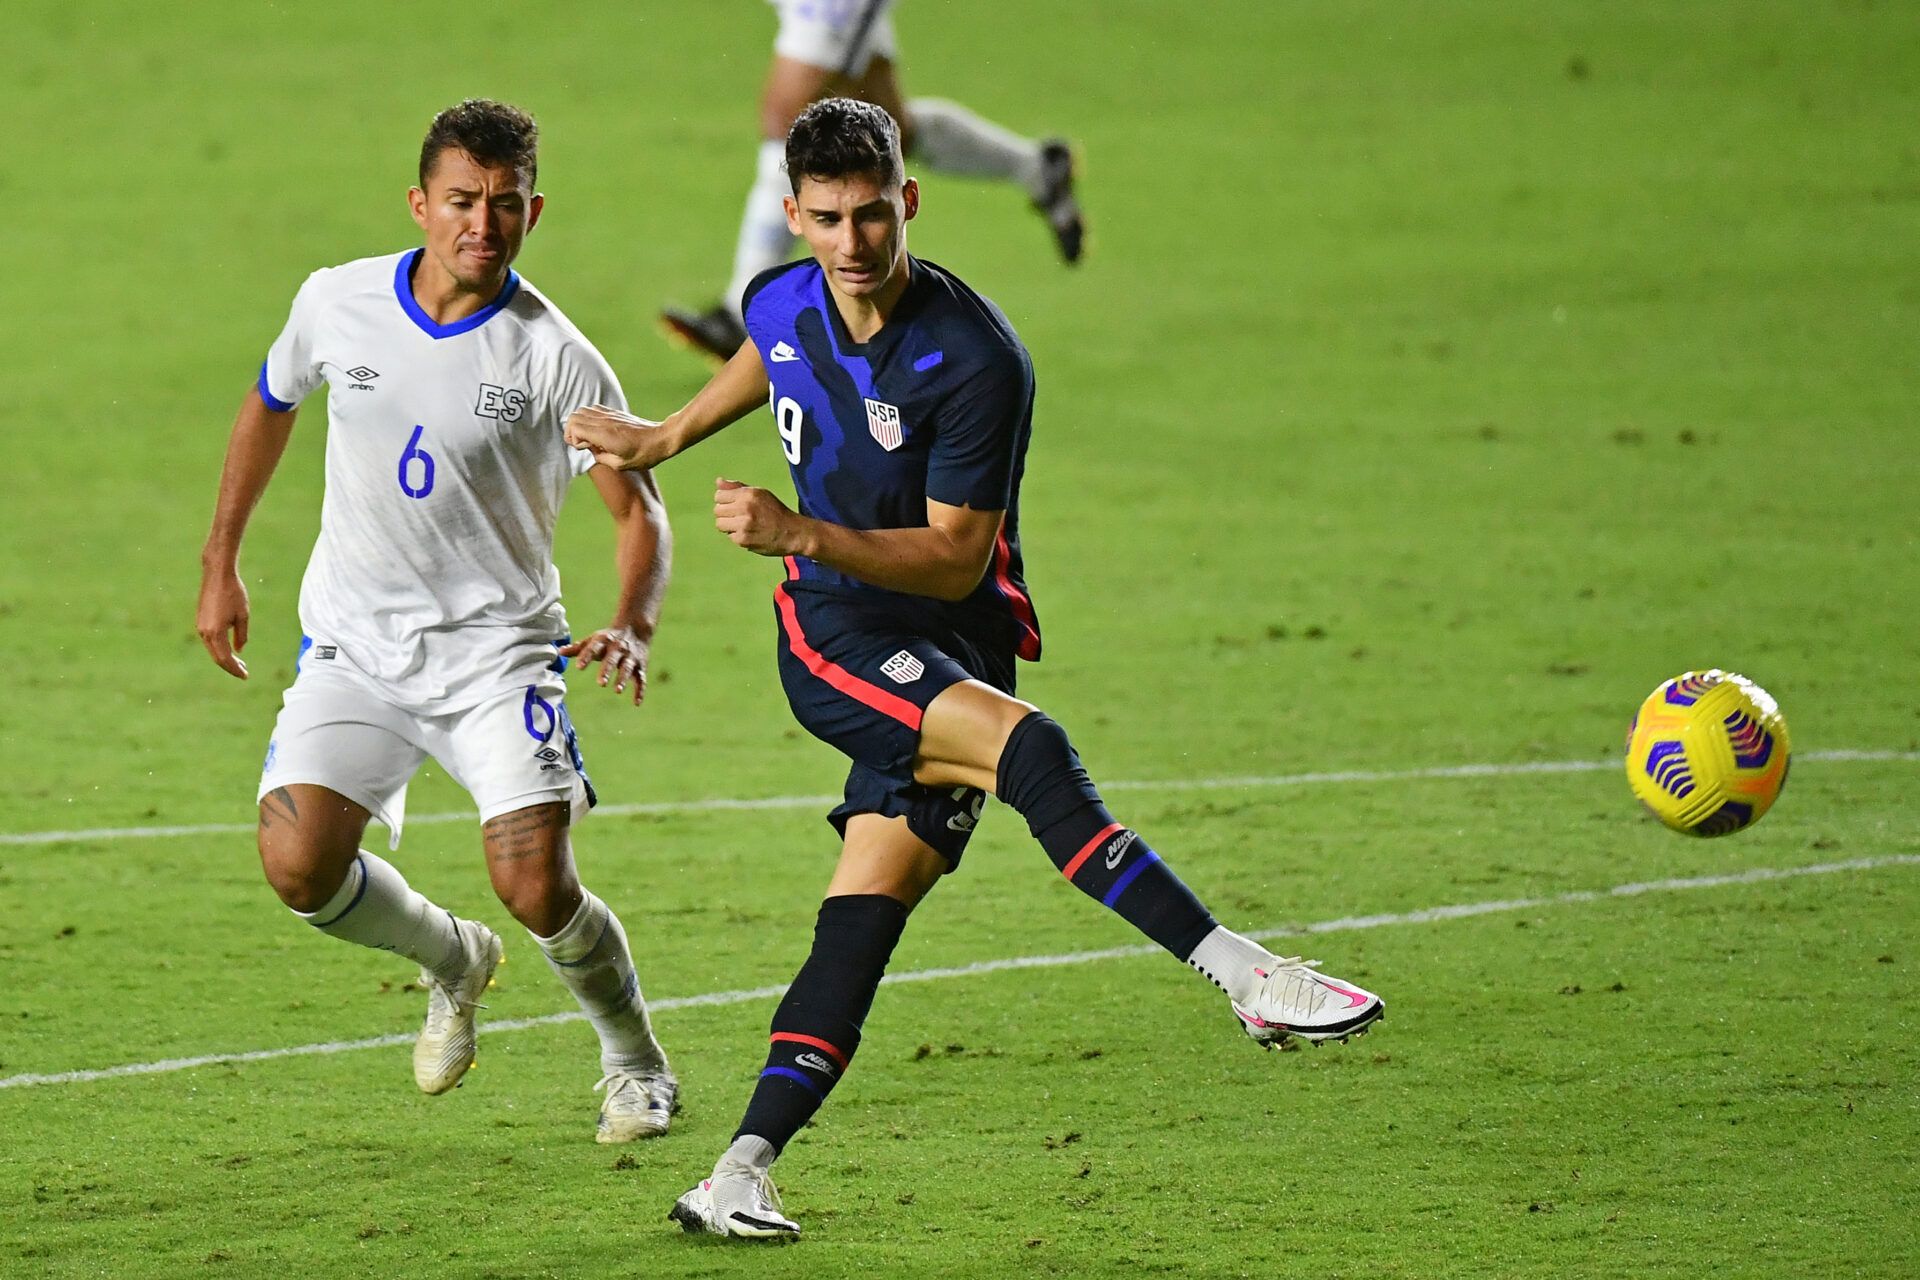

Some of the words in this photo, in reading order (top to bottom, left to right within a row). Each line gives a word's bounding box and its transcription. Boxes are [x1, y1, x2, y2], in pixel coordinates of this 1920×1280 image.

[347, 382, 375, 391] umbro
[475, 383, 526, 423] ES
[769, 380, 803, 466] 9
[867, 401, 898, 423] USA
[398, 424, 435, 499] 6
[883, 652, 911, 673] USA
[523, 684, 556, 743] 6
